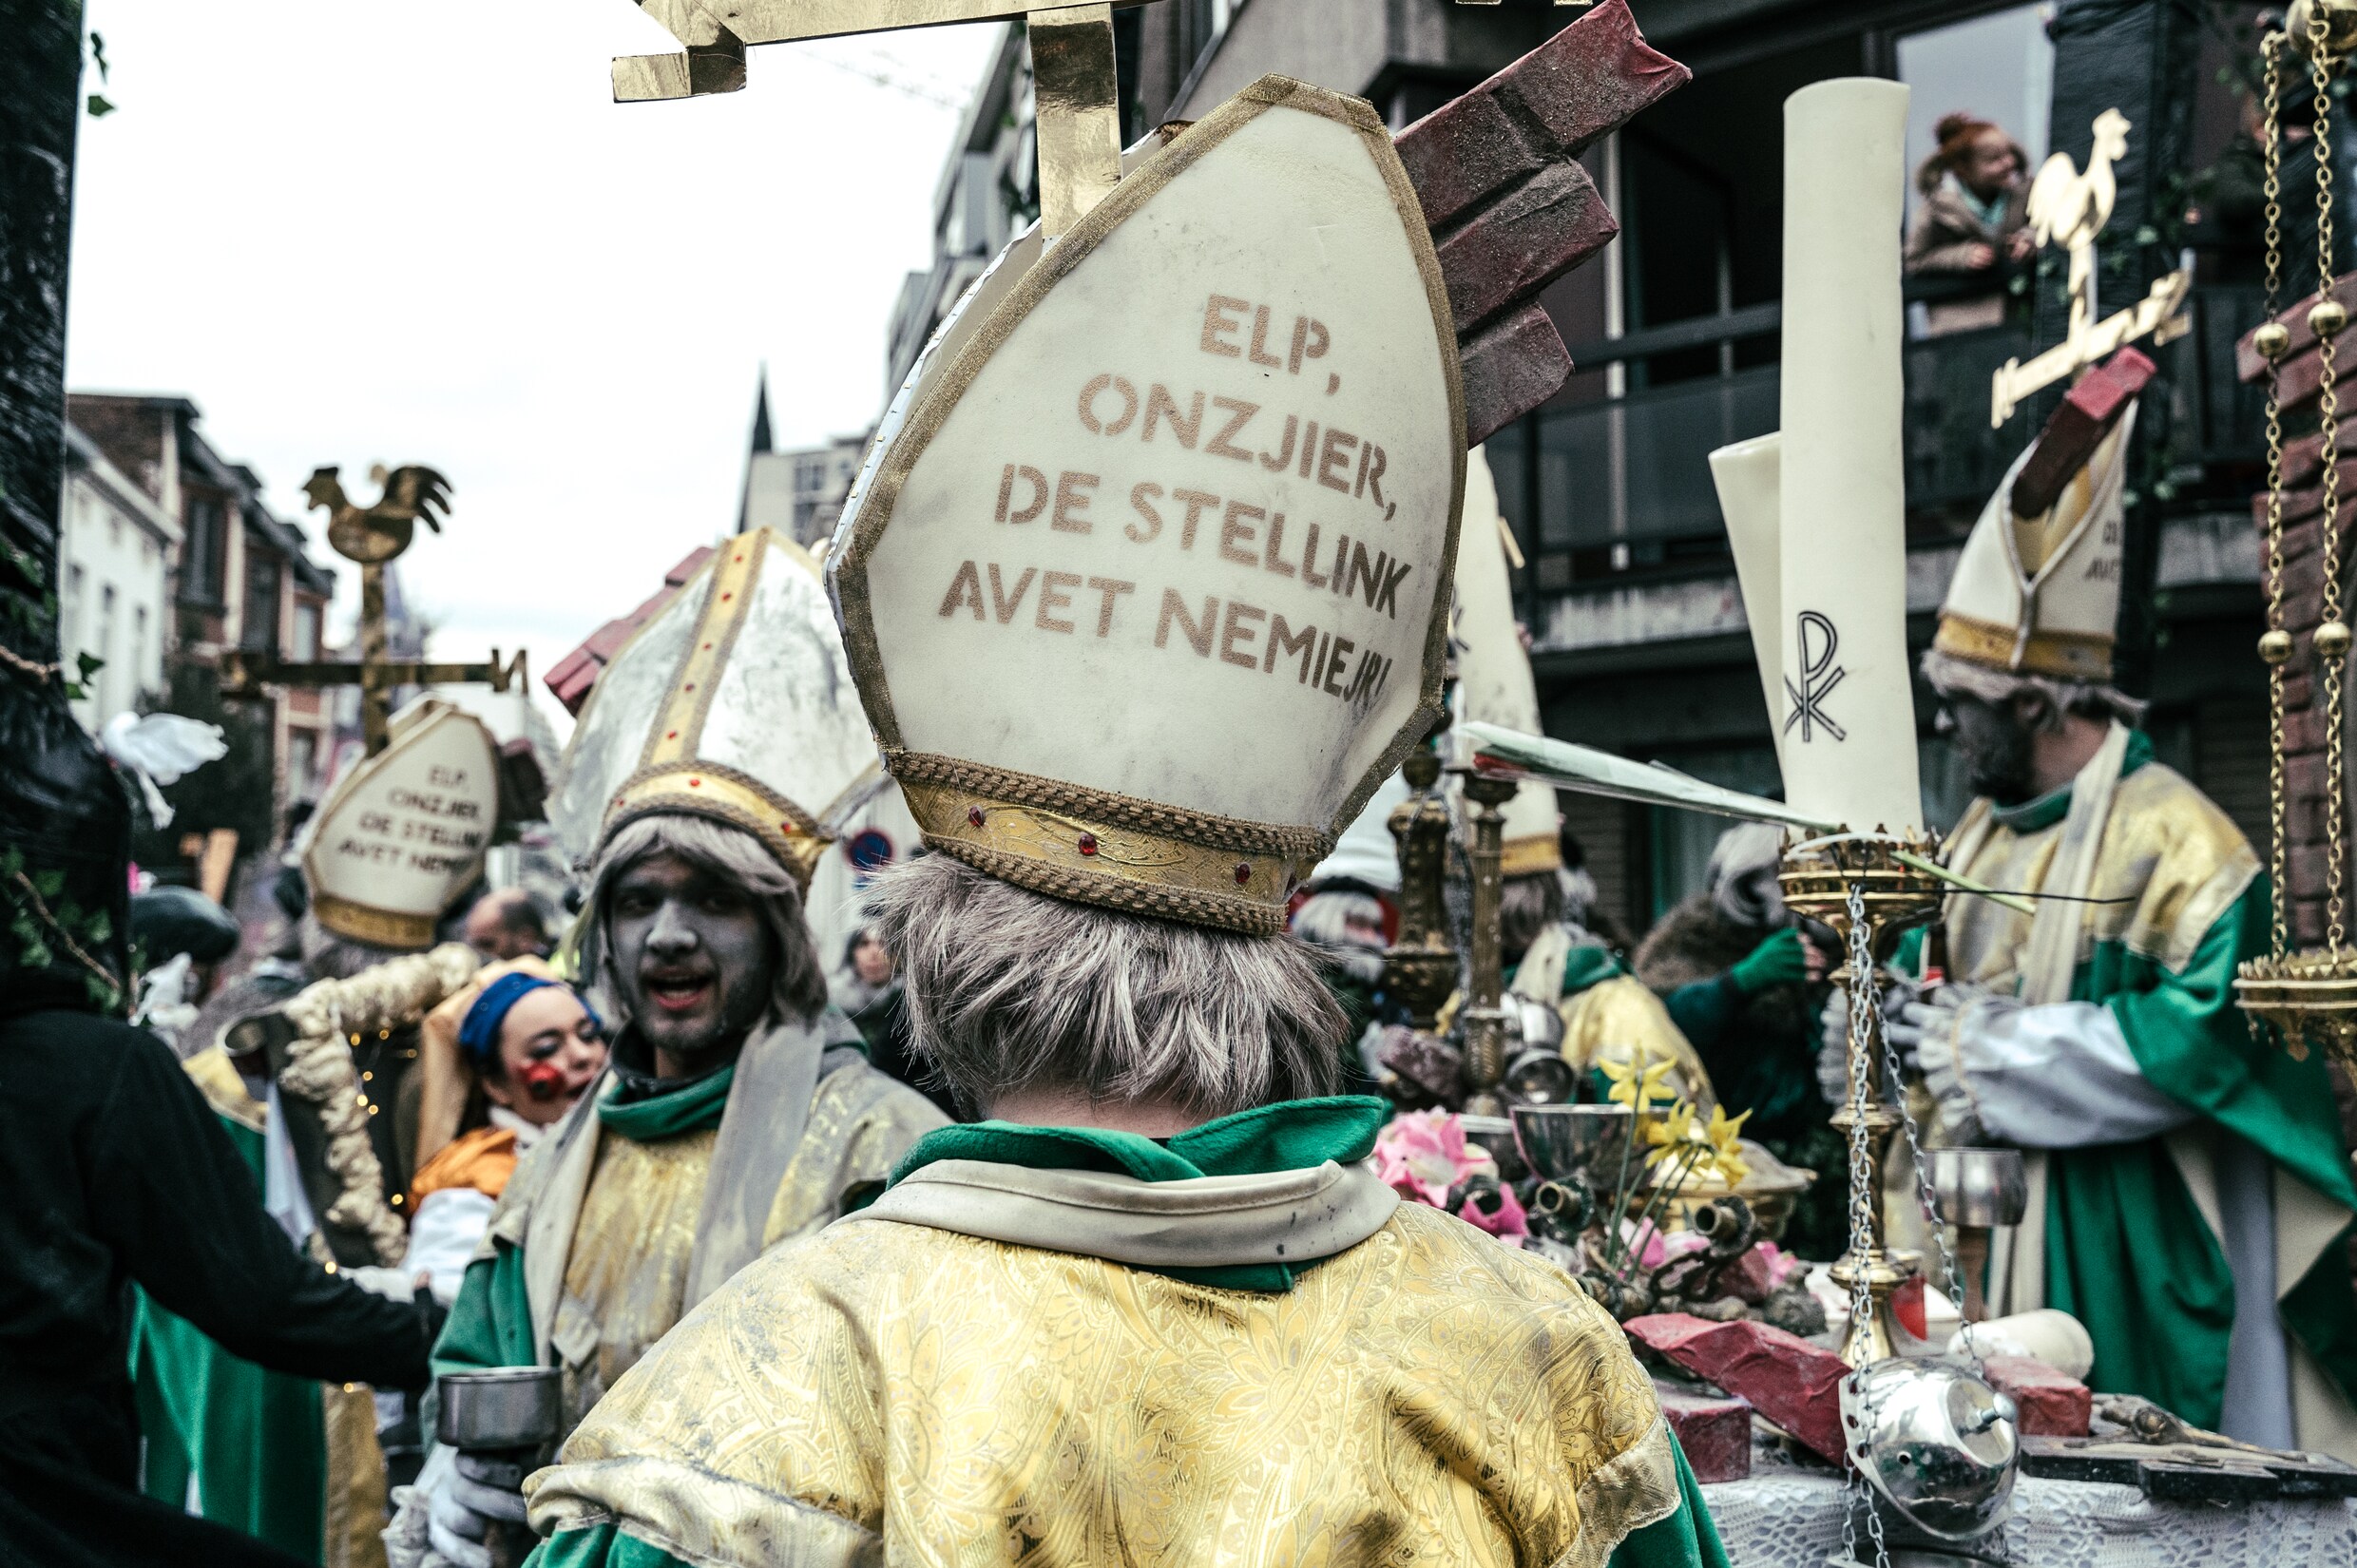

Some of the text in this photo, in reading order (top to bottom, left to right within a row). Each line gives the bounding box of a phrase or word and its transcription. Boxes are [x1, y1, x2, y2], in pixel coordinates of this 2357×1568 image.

[1200, 294, 1341, 395] ELP,
[1078, 373, 1397, 522] ONZJIER,
[994, 463, 1412, 620] DE STELLINK
[938, 559, 1392, 707] AVET NEMIEJR!
